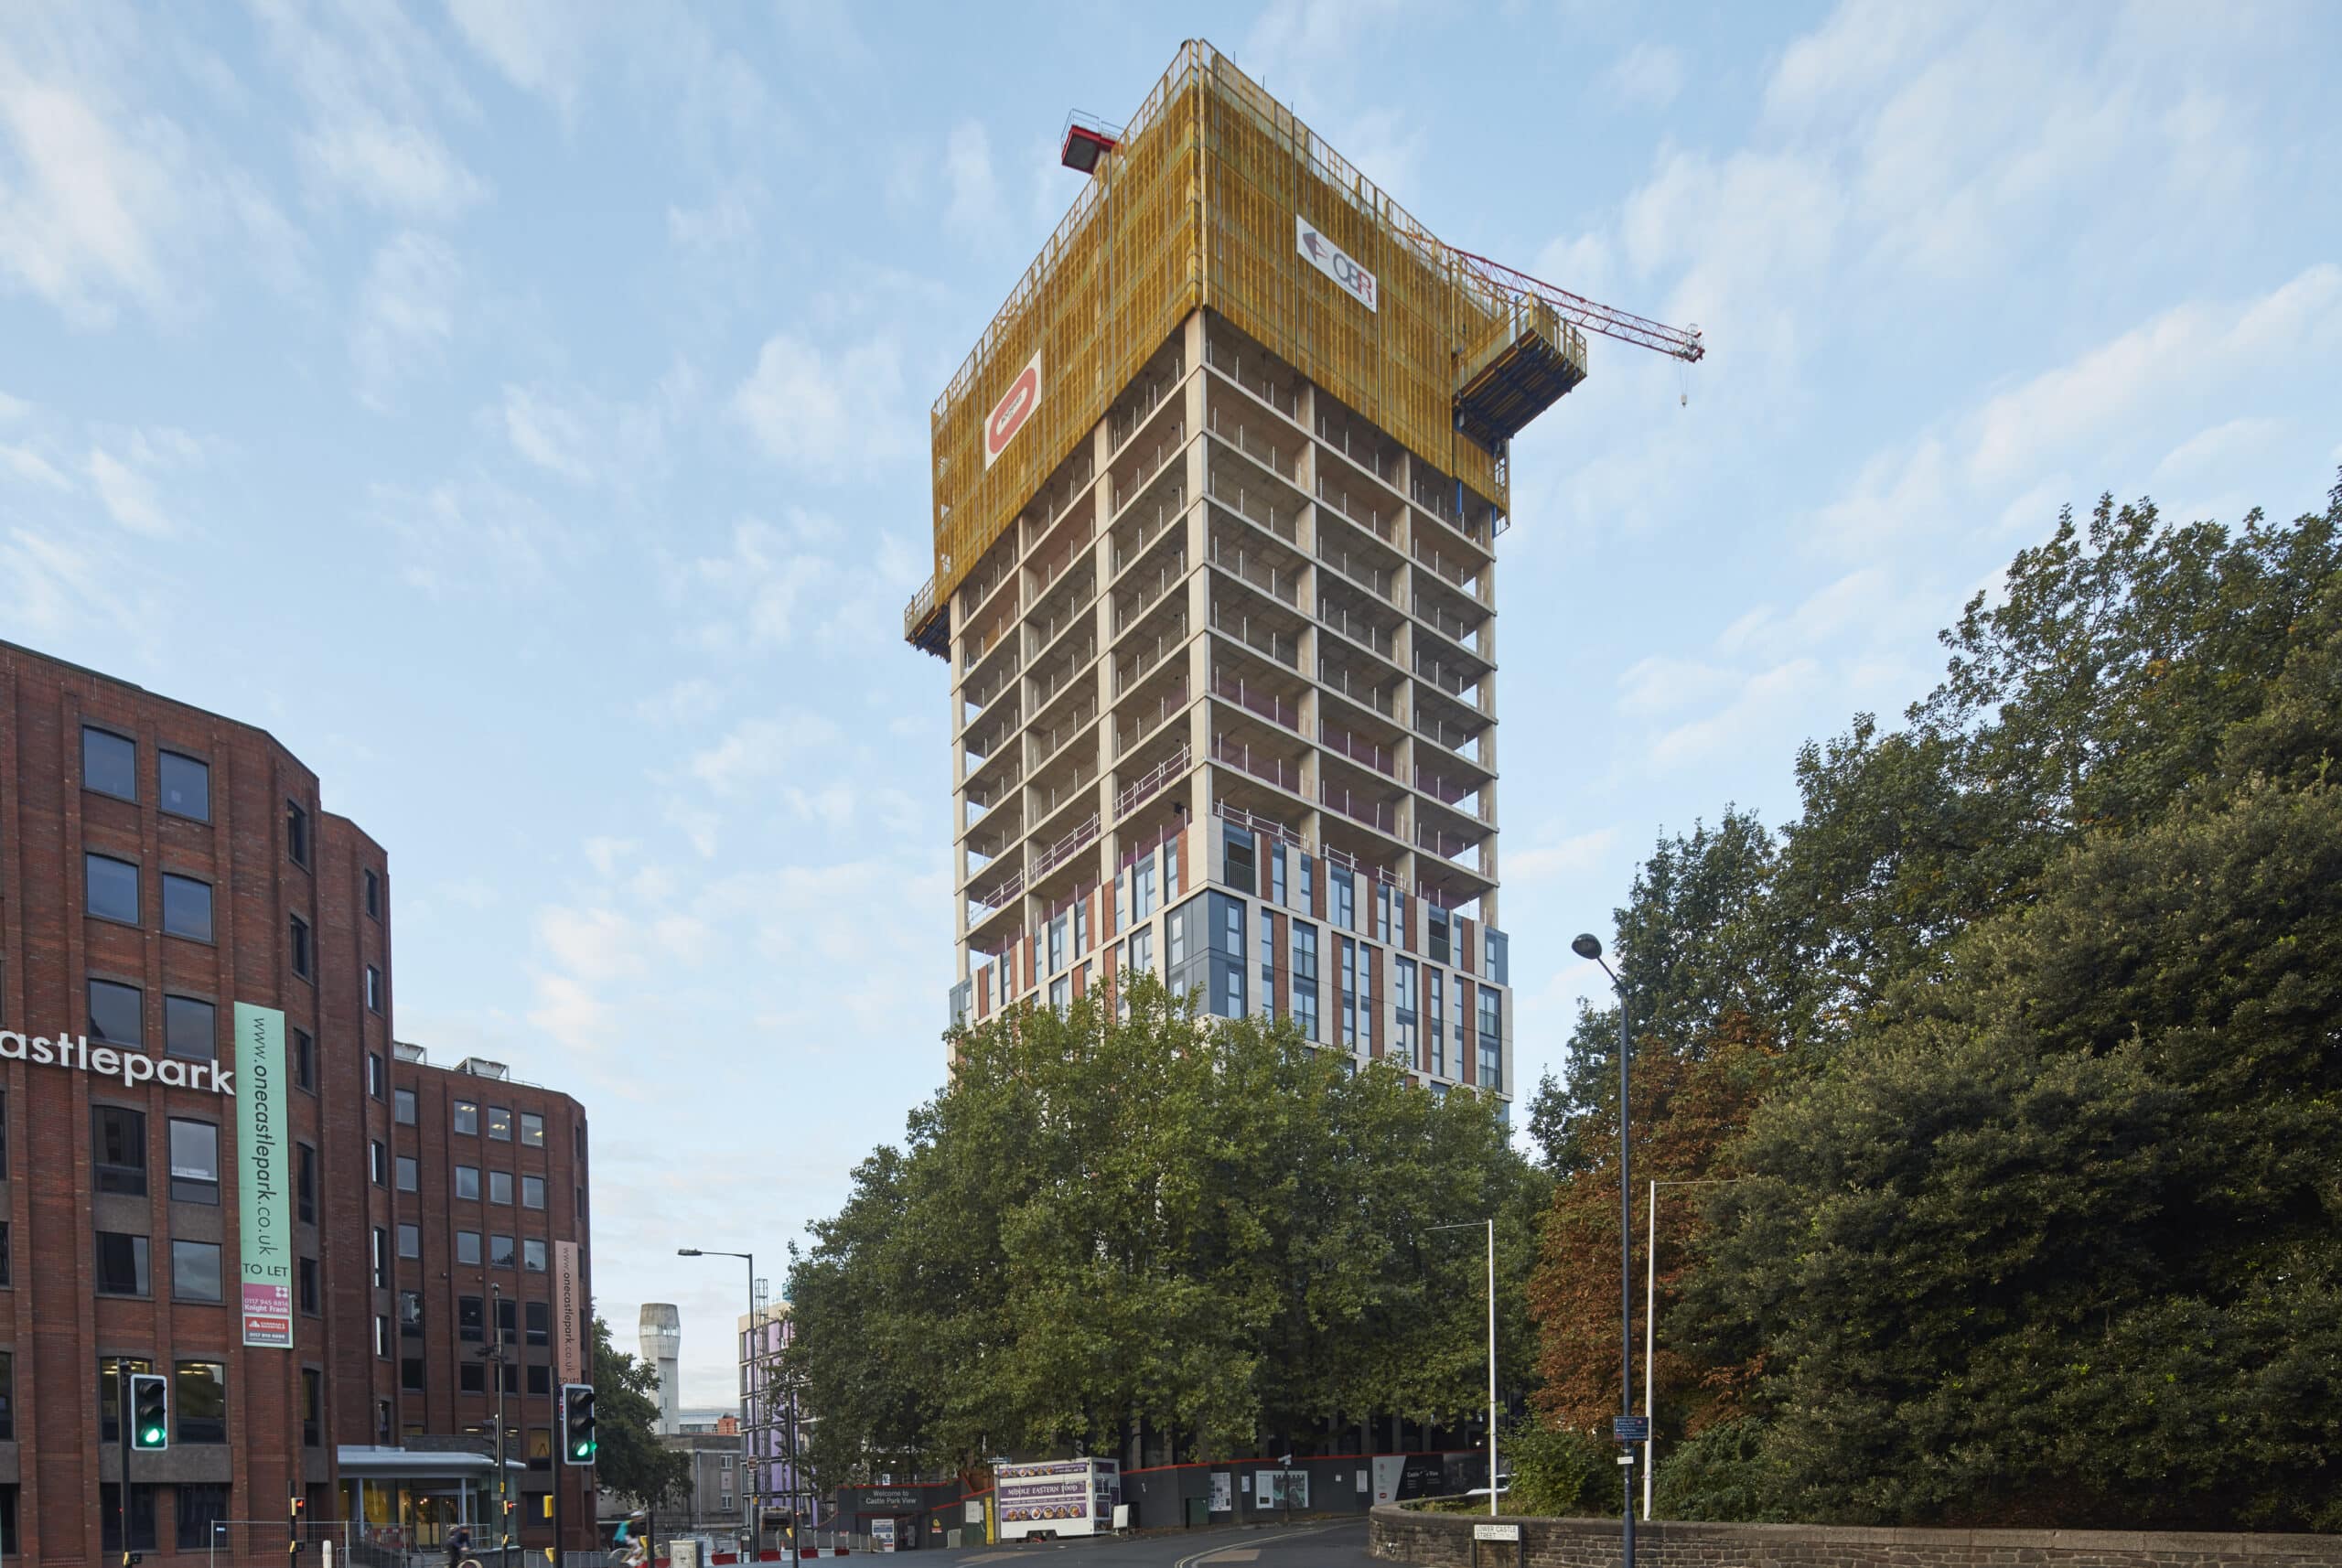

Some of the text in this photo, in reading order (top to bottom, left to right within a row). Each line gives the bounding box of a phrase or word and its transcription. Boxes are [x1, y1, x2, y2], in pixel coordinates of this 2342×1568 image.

[252, 1017, 278, 1255] www.onecastlepark.co.uk
[242, 1263, 288, 1277] TO LET
[244, 1304, 288, 1314] Knight Frank
[563, 1247, 575, 1372] www.onecastlepark.co.uk
[865, 1497, 917, 1505] Castle Park View
